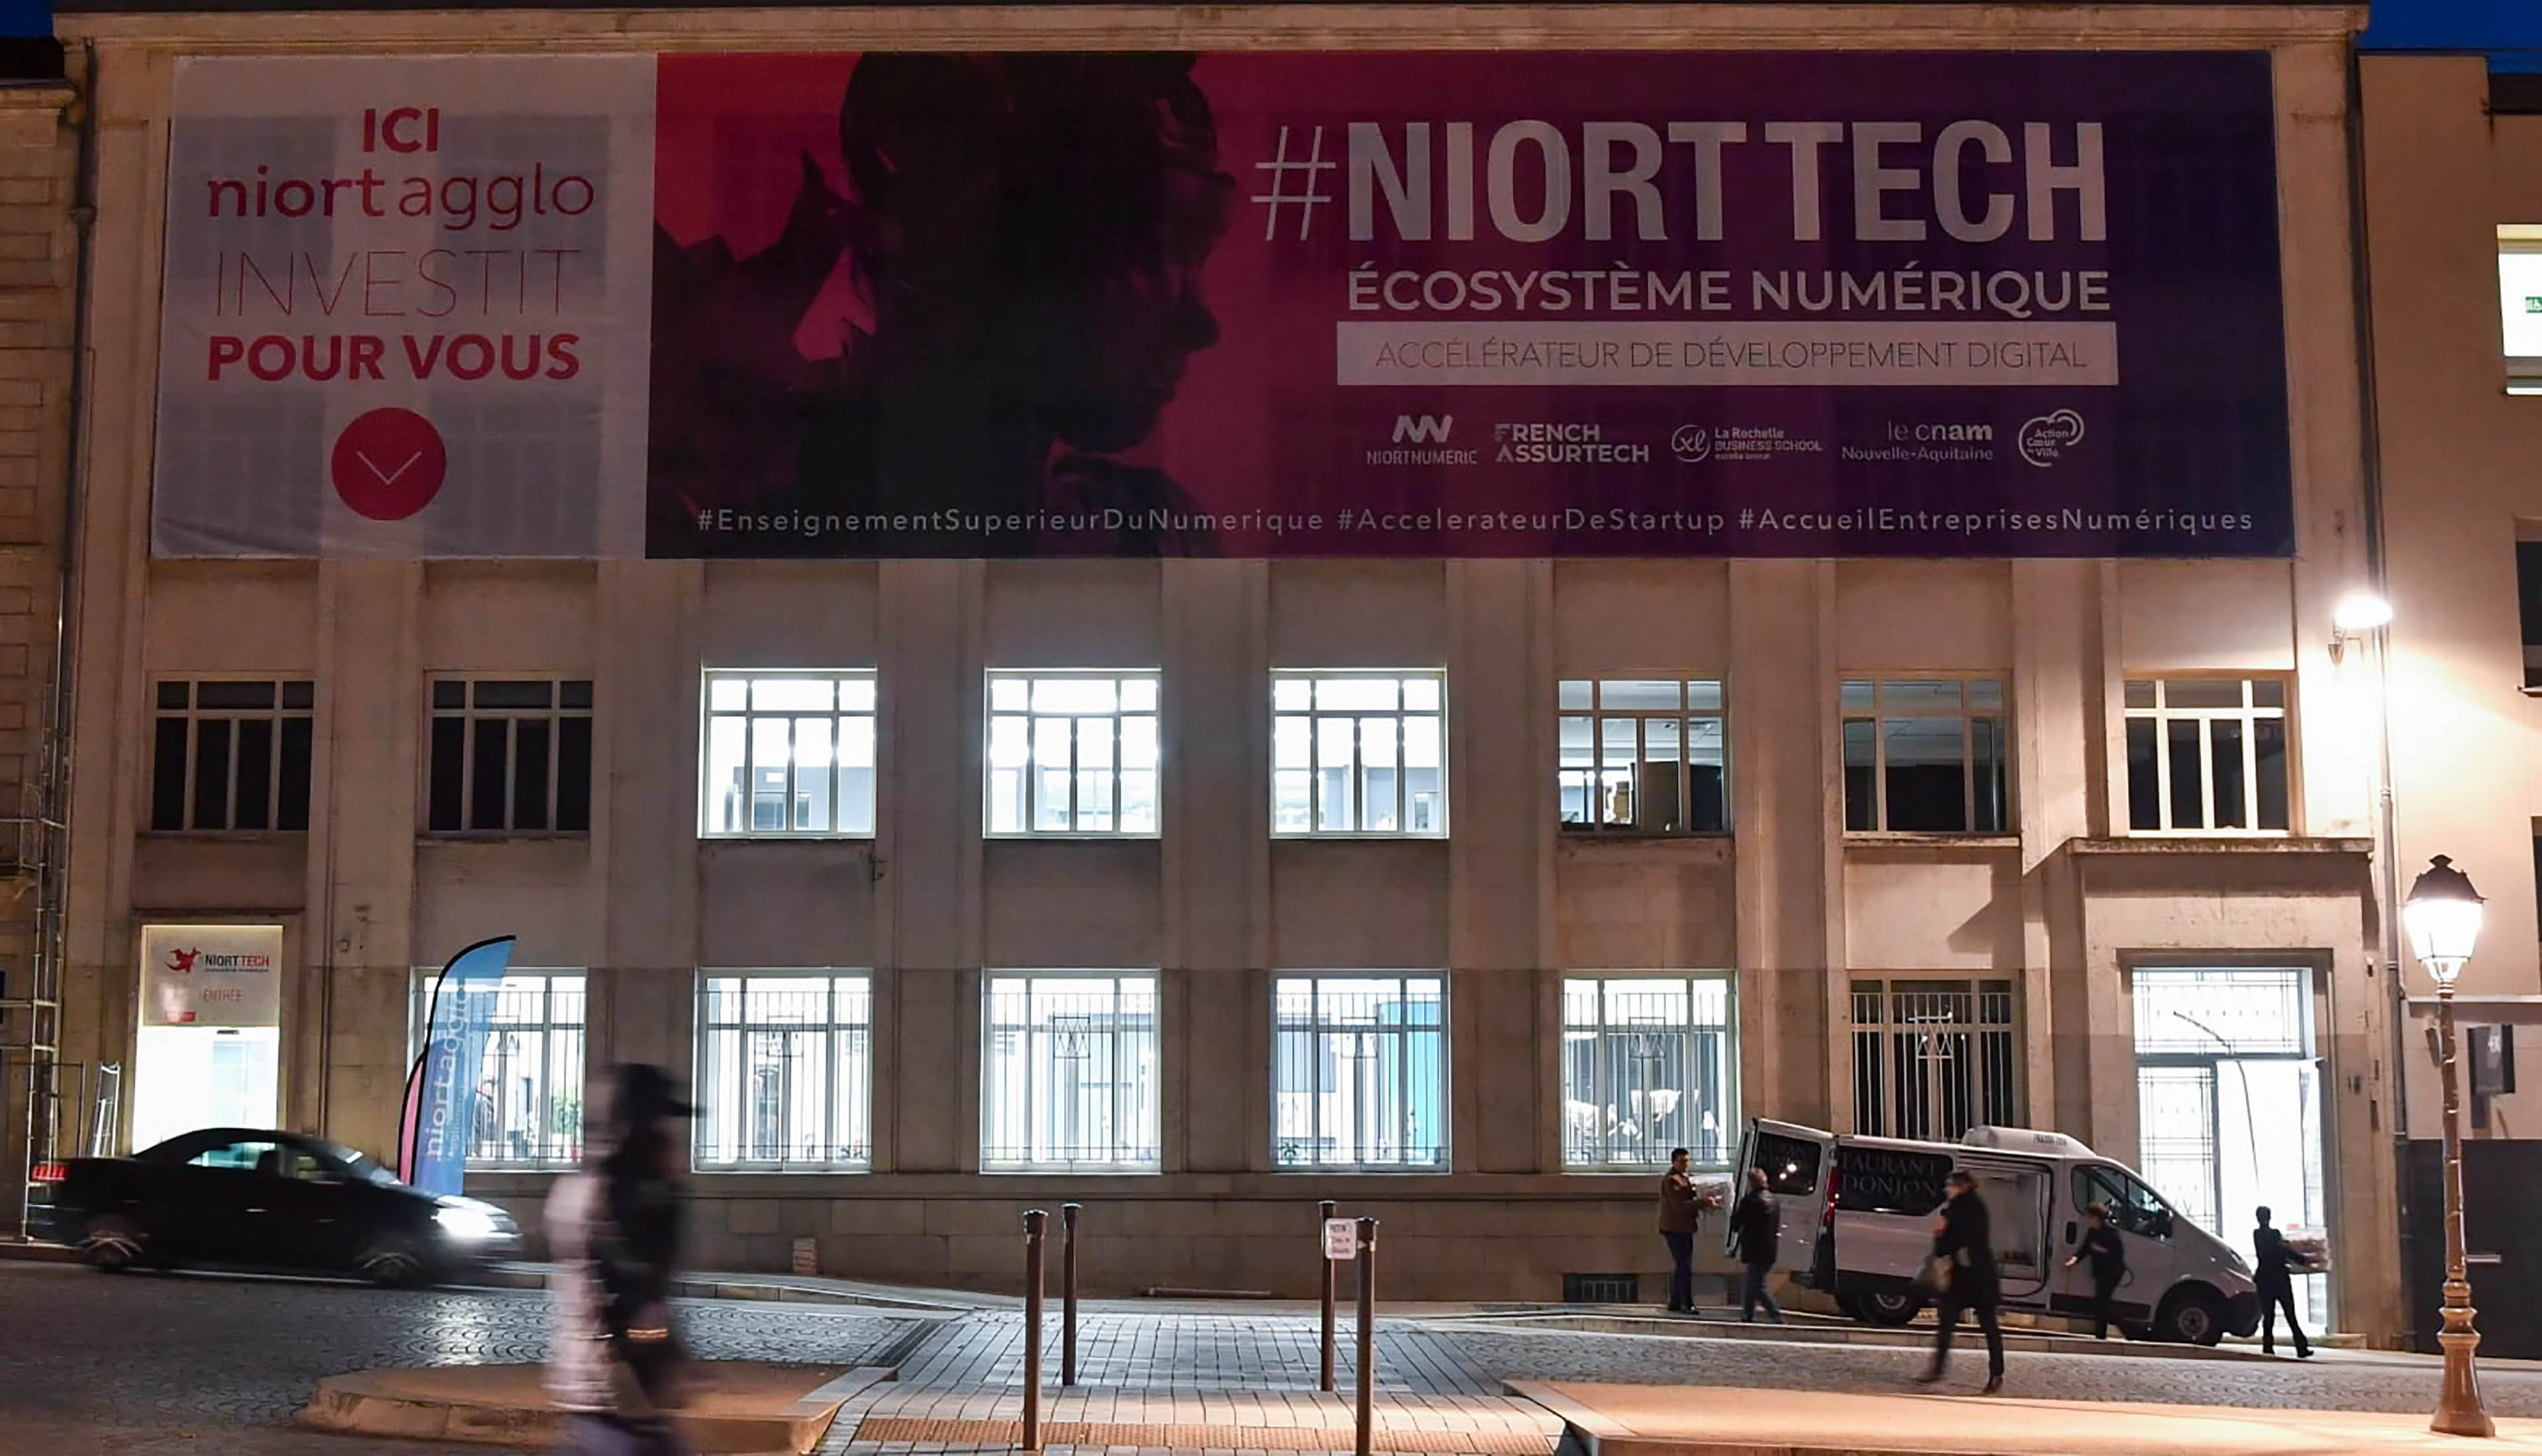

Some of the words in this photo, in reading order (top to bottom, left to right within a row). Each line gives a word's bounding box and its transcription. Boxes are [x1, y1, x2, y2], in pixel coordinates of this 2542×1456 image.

[363, 107, 439, 153] ICI
[1765, 120, 2106, 242] TECH
[216, 248, 583, 318] INVESTIT
[1349, 261, 1731, 311] ÉCOSYSTÈME
[1753, 261, 2110, 318] NUMÉRIQUE
[208, 335, 384, 381] POUR
[402, 333, 580, 381] VOUS
[1376, 336, 1619, 369] ACCÉLÉRATEUR
[1630, 341, 1673, 368] DE
[1683, 336, 1957, 369] DÉVELOPPEMENT
[1967, 341, 2087, 368] DIGITAL
[1495, 424, 1600, 442] FRENCH
[1715, 427, 1729, 439] La
[1732, 427, 1784, 439] Rochelle
[1888, 420, 1908, 441] le
[1915, 424, 1993, 441] cnam
[2034, 428, 2069, 439] Action
[1495, 444, 1649, 463] ASSURTECH
[1715, 440, 1772, 451] BUSINESS
[1775, 440, 1823, 451] SCHOOL
[1842, 445, 1993, 464] Nouvelle-Aquitaine
[698, 508, 1323, 537] #EnseignementSuperieurDuNumerique
[1338, 508, 1724, 535] #AccelerateurDeStartup
[1739, 507, 2252, 536] #AccueilEntreprisesNumériques
